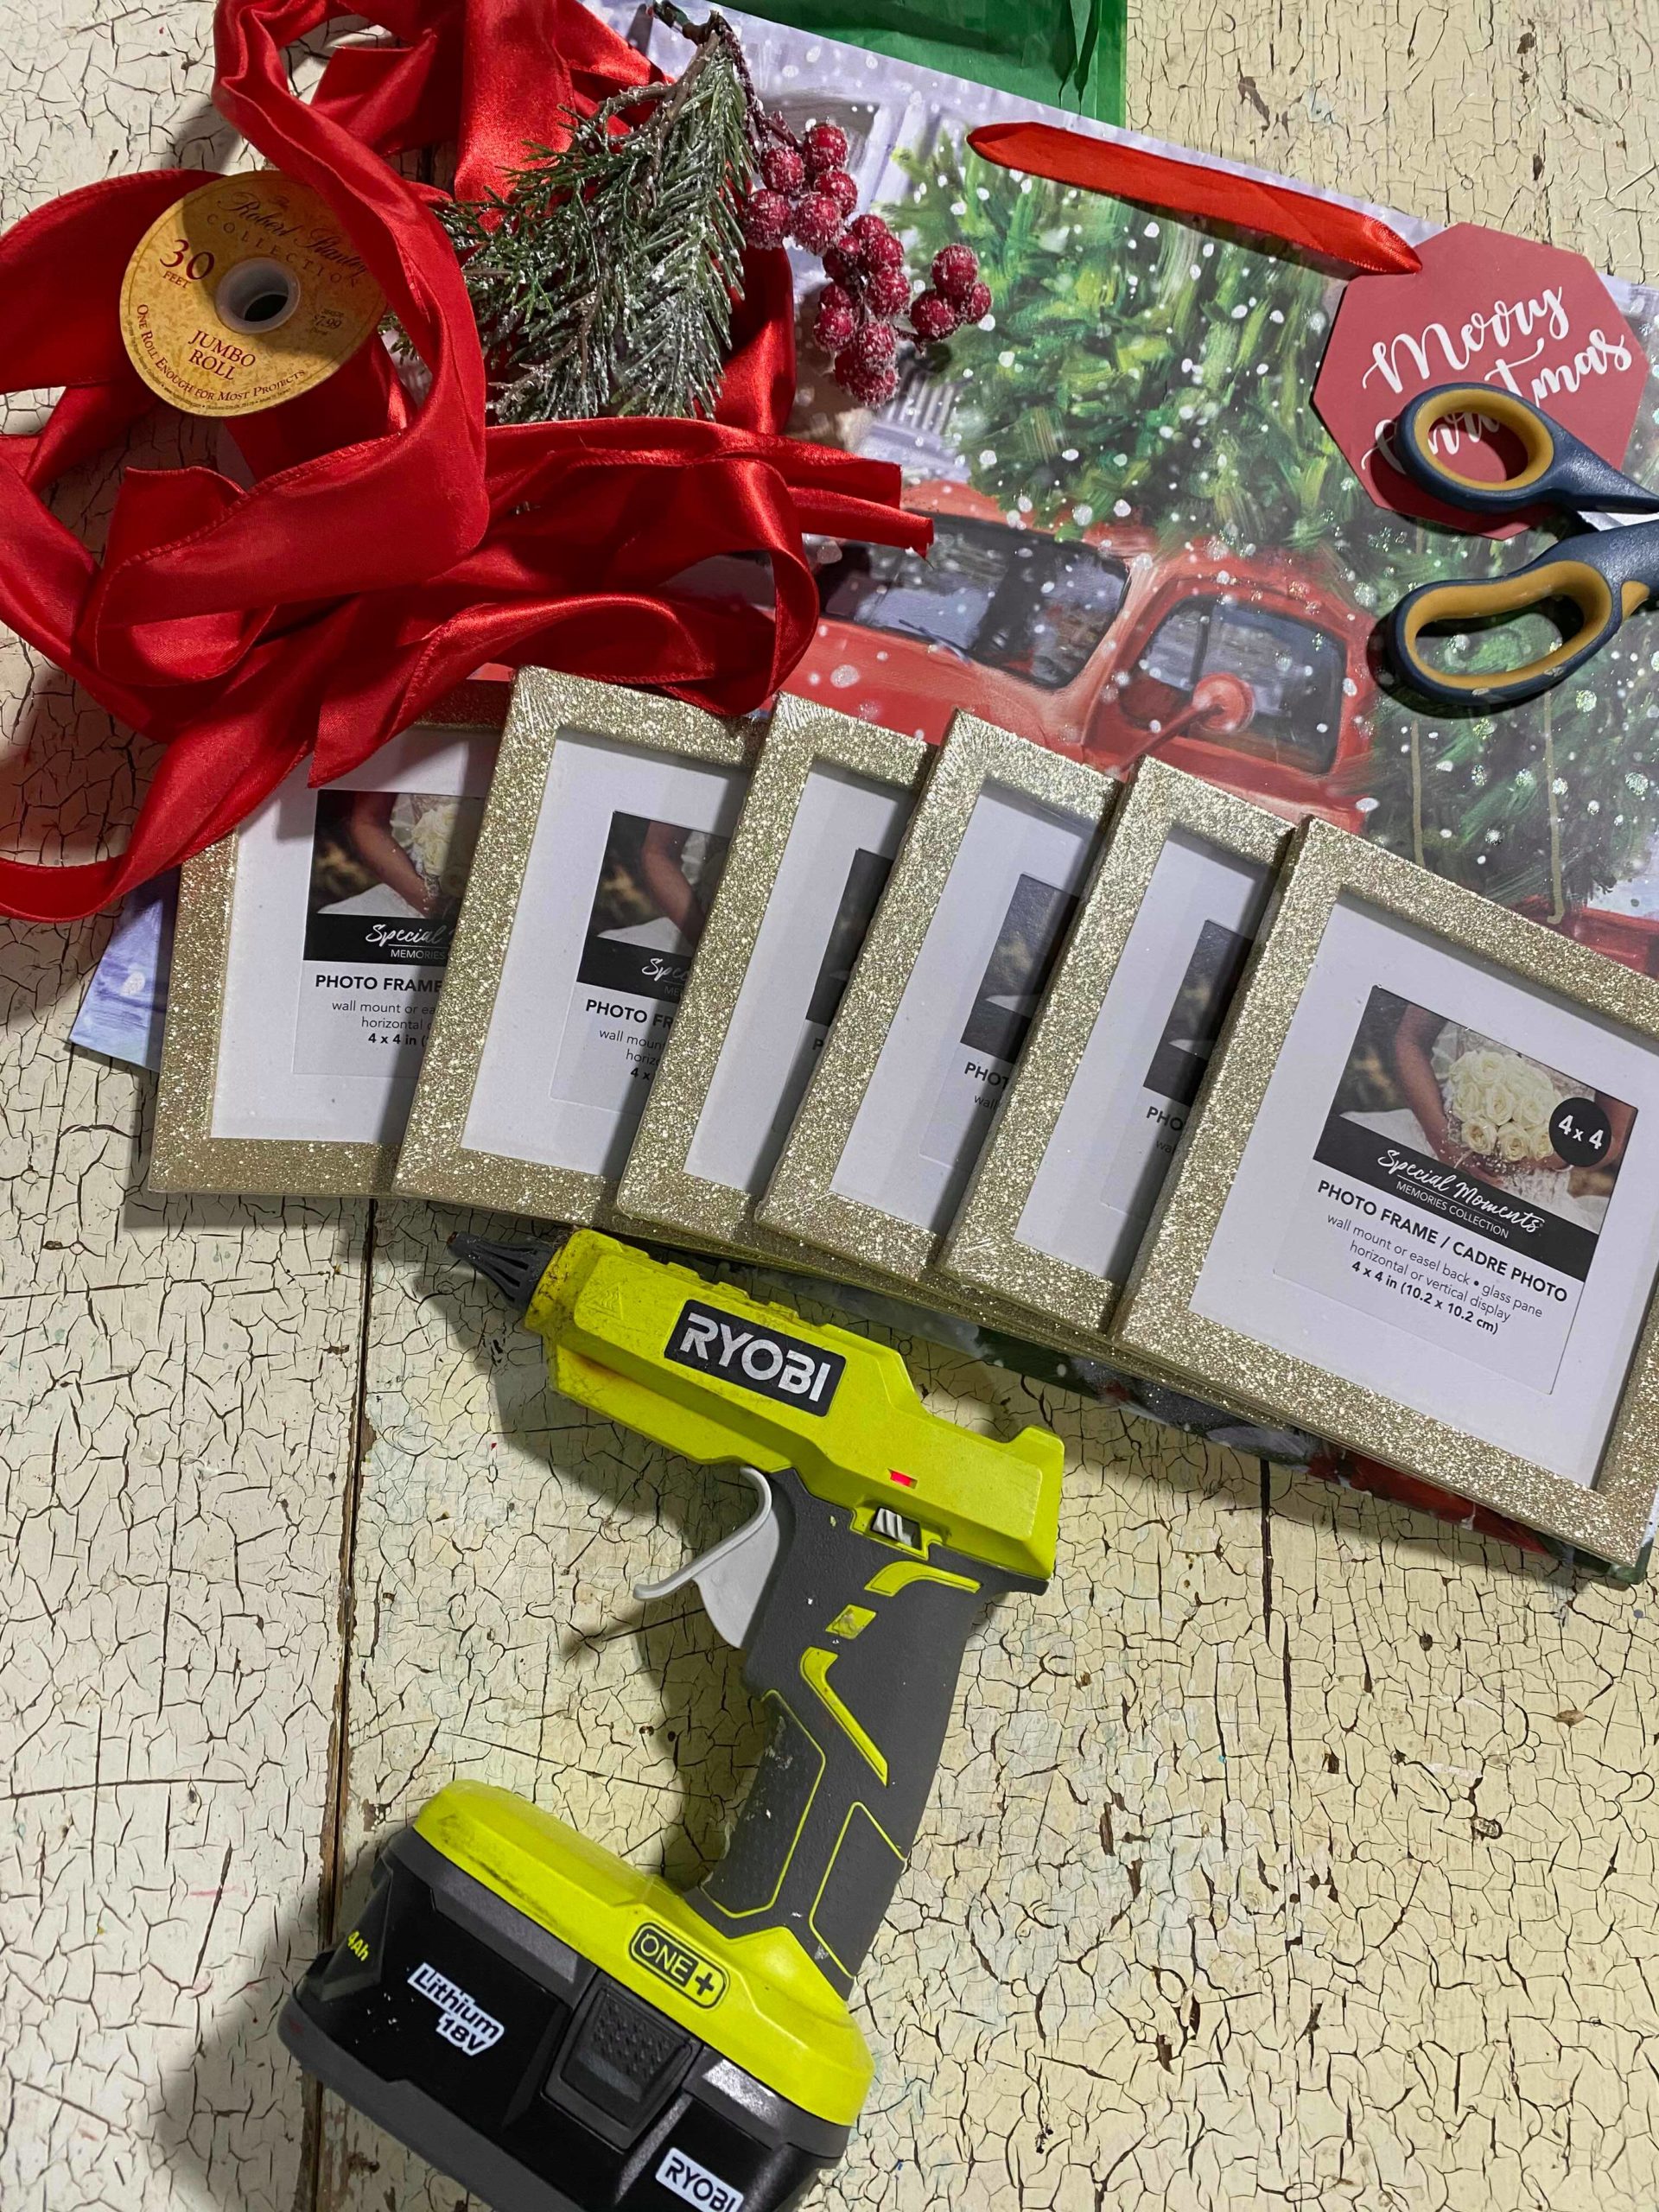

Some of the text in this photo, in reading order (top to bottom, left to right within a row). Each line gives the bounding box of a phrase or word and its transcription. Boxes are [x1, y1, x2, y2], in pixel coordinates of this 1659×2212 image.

[160, 238, 215, 280] 30
[162, 270, 191, 289] FEET
[188, 330, 256, 368] JUMBO
[1362, 286, 1570, 394] Merry
[188, 349, 235, 380] ROLL
[365, 924, 447, 946] Special
[391, 949, 446, 960] MEMORIES
[315, 974, 378, 990] PHOTO
[332, 1001, 356, 1013] wall
[360, 1002, 401, 1014] mount
[404, 1006, 419, 1014] or
[361, 1016, 423, 1030] horizontal
[586, 999, 647, 1023] PHOTO
[368, 1033, 377, 1044] 4
[380, 1036, 389, 1045] x
[392, 1034, 402, 1045] 4
[405, 1033, 416, 1046] in
[600, 1029, 623, 1042] wall
[631, 1067, 651, 1080] 4 x
[964, 1062, 1009, 1090] PHOT
[1147, 1106, 1184, 1131] PHO
[1558, 1115, 1604, 1150] 4 x 4
[1156, 1141, 1173, 1154] wa
[1377, 1149, 1545, 1233] Special Moments
[1396, 1181, 1510, 1239] MEMORIES COLLECTION
[1318, 1179, 1568, 1302] PHOTO FRAME / CADRE PHOTO
[1327, 1214, 1542, 1318] wall mount or easel back glass pane
[1350, 1240, 1511, 1323] horizontal or vertical display
[1351, 1261, 1499, 1335] 4 x 4 in (10.2 x 10.2 cm)
[680, 1313, 831, 1402] RYOBI
[347, 1929, 370, 1961] 4Ah
[414, 1969, 500, 2040] Lithium
[443, 2018, 486, 2053] 18V
[664, 2156, 736, 2212] RYOBI
